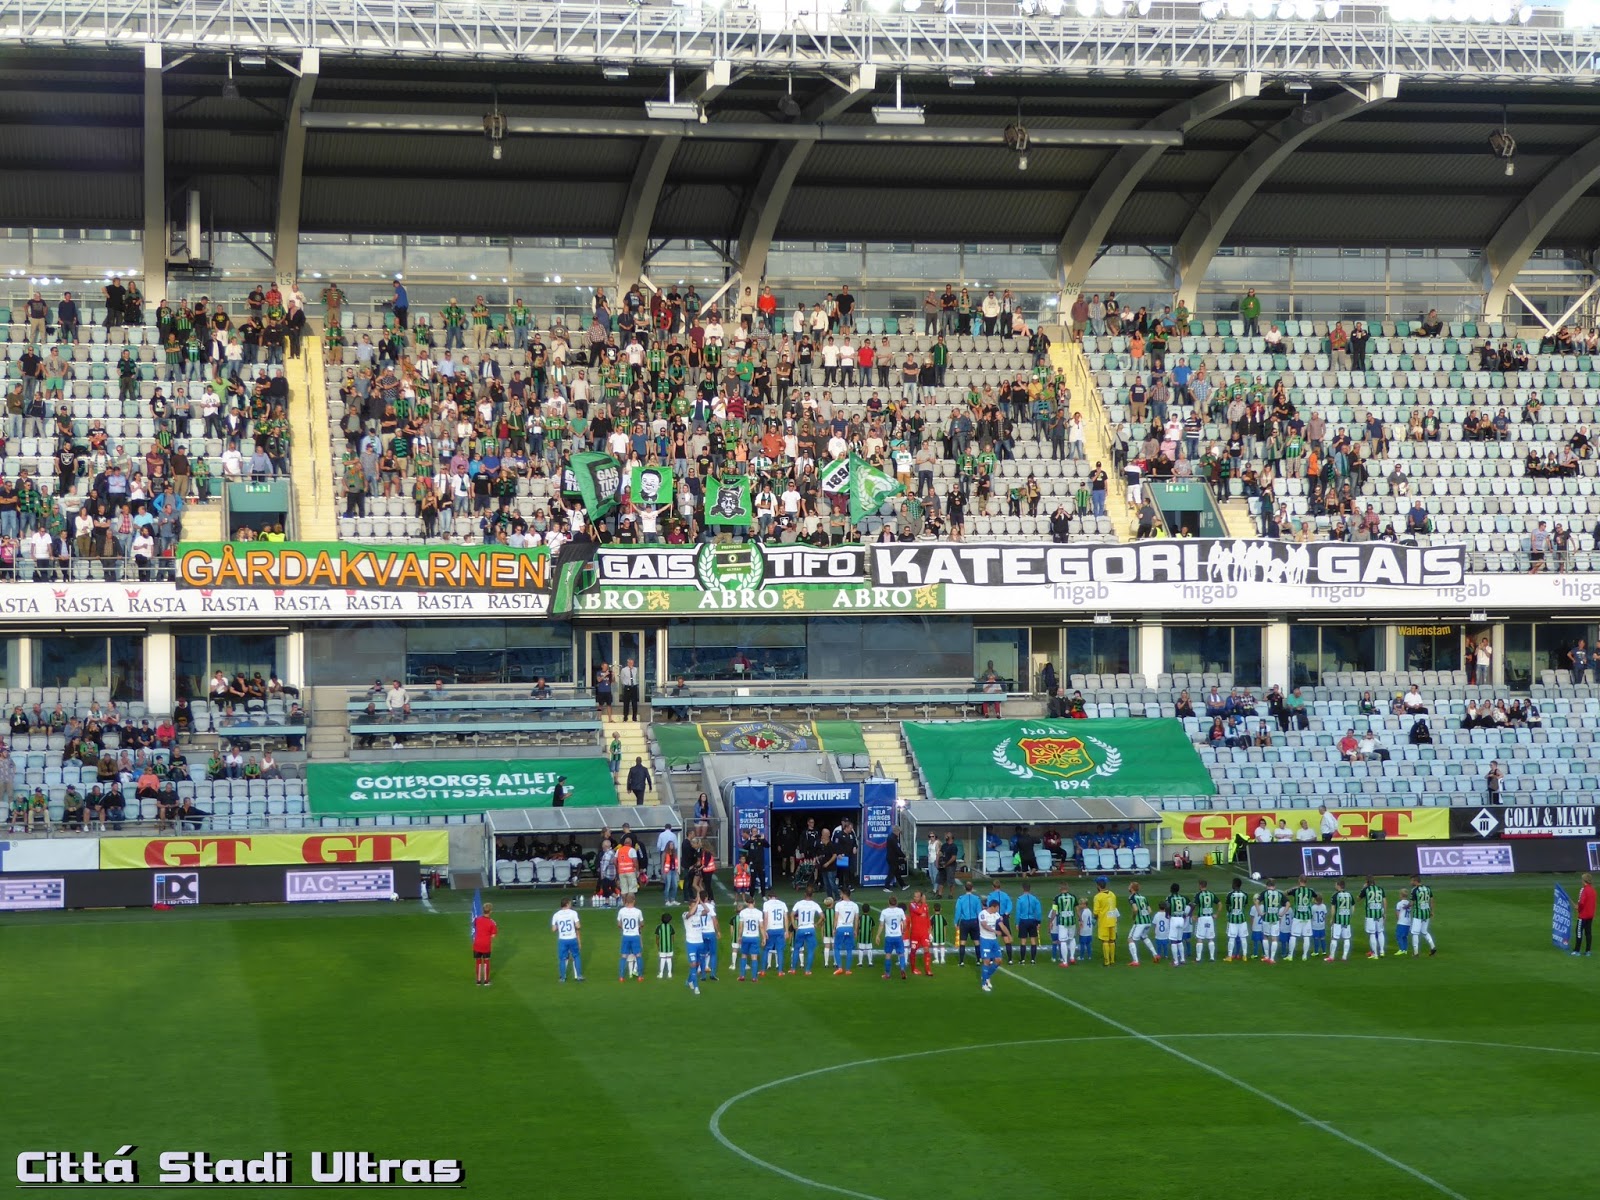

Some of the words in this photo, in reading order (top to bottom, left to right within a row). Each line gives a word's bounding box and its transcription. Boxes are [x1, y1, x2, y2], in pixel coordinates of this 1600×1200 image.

[596, 466, 619, 480] GAIS
[599, 478, 619, 491] TIFO
[181, 544, 546, 588] GÅRDAKVARNEN
[602, 555, 695, 579] GAIS
[768, 553, 856, 577] TIFO
[876, 544, 1199, 584] KATEGORI
[1317, 546, 1462, 585] GAIS
[1053, 581, 1109, 605] higab
[55, 598, 114, 612] RASTA
[128, 597, 187, 612] RASTA
[202, 597, 259, 611] RASTA
[275, 596, 332, 611] RASTA
[346, 596, 403, 610] RASTA
[417, 595, 474, 609] RASTA
[488, 595, 544, 609] RASTA
[1398, 625, 1451, 636] Wallenstam
[1053, 780, 1091, 790] 1894
[350, 791, 368, 801] &
[797, 790, 851, 801] STRYKTIPSET
[1504, 808, 1540, 827] GOLV
[1543, 807, 1553, 826] &
[1556, 807, 1595, 827] MATT
[144, 837, 251, 868] GT
[302, 834, 407, 864] GT
[1424, 851, 1461, 866] IAC
[294, 877, 334, 892] IAC
[772, 909, 782, 921] 15
[801, 910, 811, 922] 11
[844, 911, 851, 923] 7
[559, 920, 572, 933] 25
[623, 917, 636, 930] 20
[746, 919, 756, 931] 16
[891, 918, 897, 930] 5
[1159, 921, 1165, 933] 8
